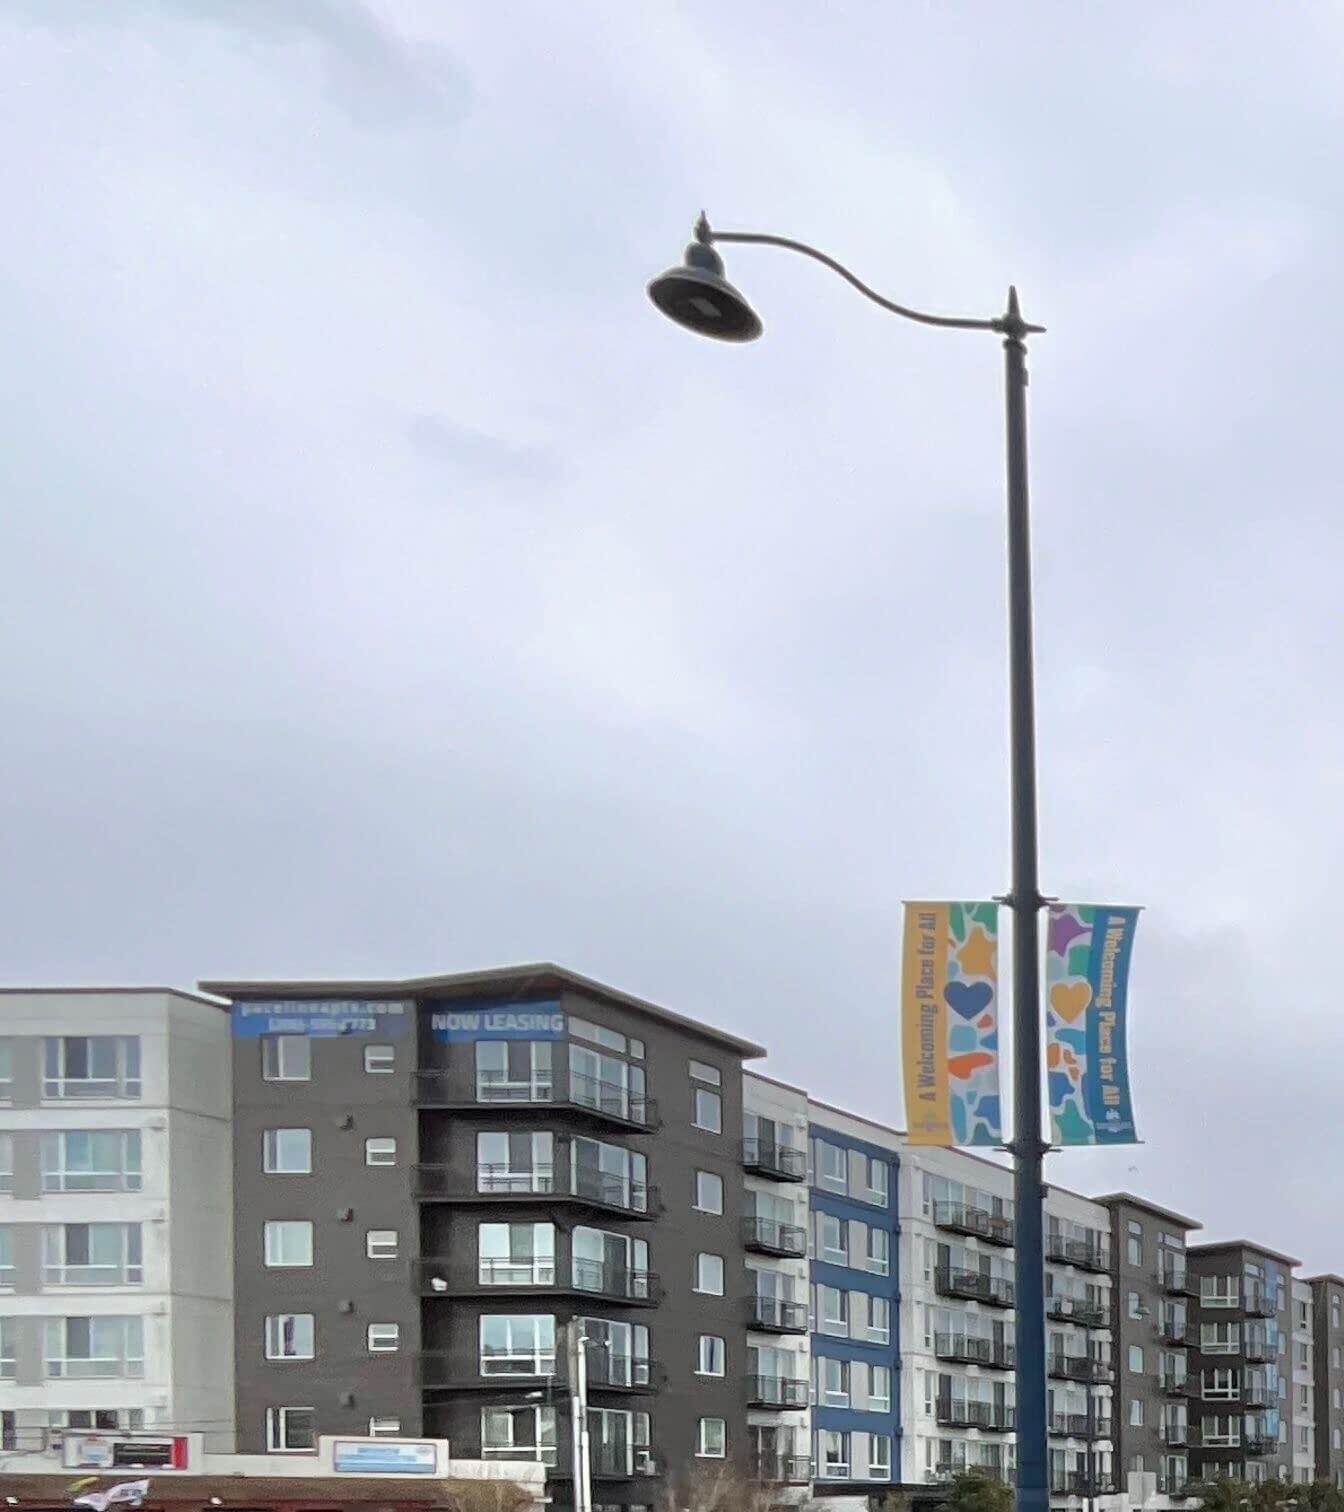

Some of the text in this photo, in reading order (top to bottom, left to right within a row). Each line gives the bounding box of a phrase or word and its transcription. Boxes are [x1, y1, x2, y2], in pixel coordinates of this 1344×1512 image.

[918, 912, 937, 930] All
[917, 935, 936, 955] for
[1095, 928, 1124, 1008] Welcoming
[916, 959, 935, 999] Place
[431, 1013, 564, 1032] NOW LEASING
[916, 1004, 938, 1088] Welcoming
[1099, 1056, 1118, 1081] for
[919, 1092, 936, 1102] A
[1101, 1085, 1120, 1106] All
